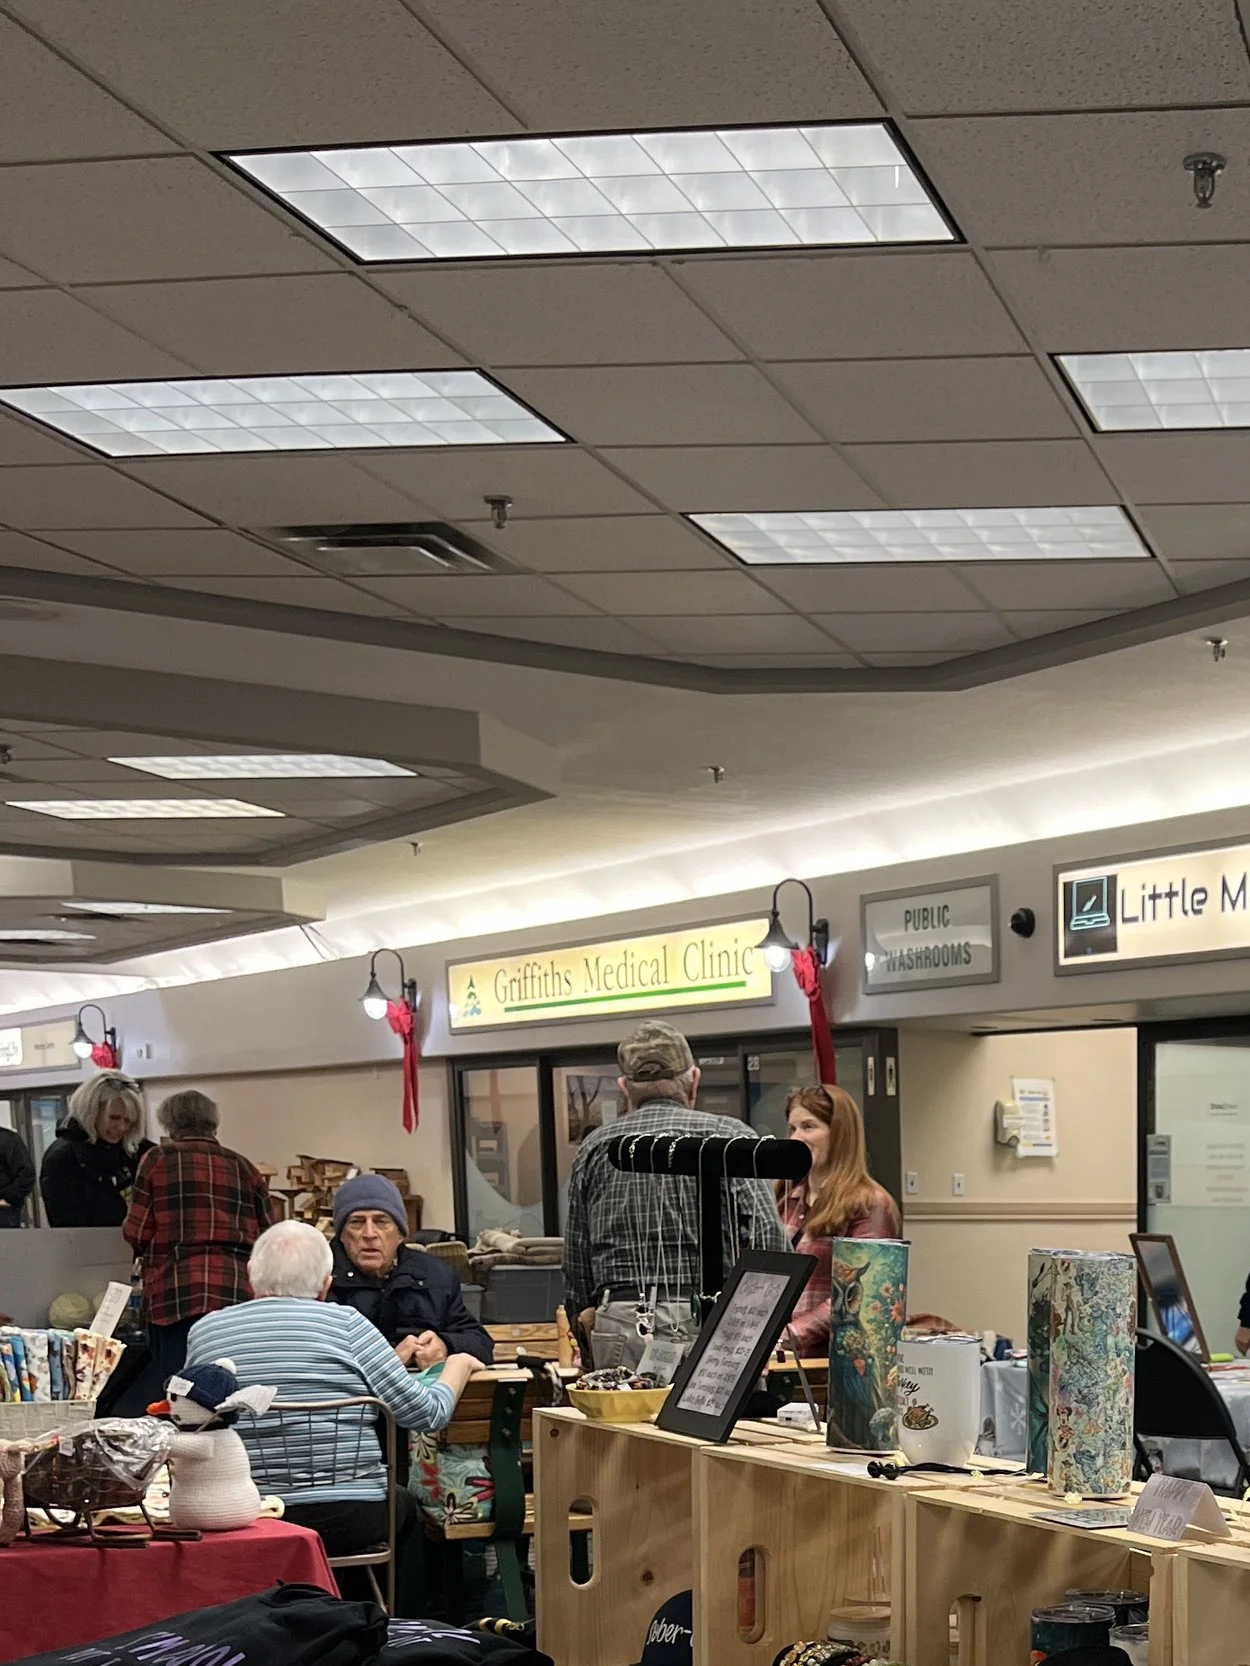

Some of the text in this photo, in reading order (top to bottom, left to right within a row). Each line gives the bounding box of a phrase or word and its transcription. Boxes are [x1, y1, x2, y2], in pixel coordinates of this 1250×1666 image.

[903, 904, 951, 932] PUBLIC
[1120, 878, 1208, 925] Little
[493, 937, 755, 1004] Griffiths Medical Clinic
[884, 941, 972, 973] WASHROOMS
